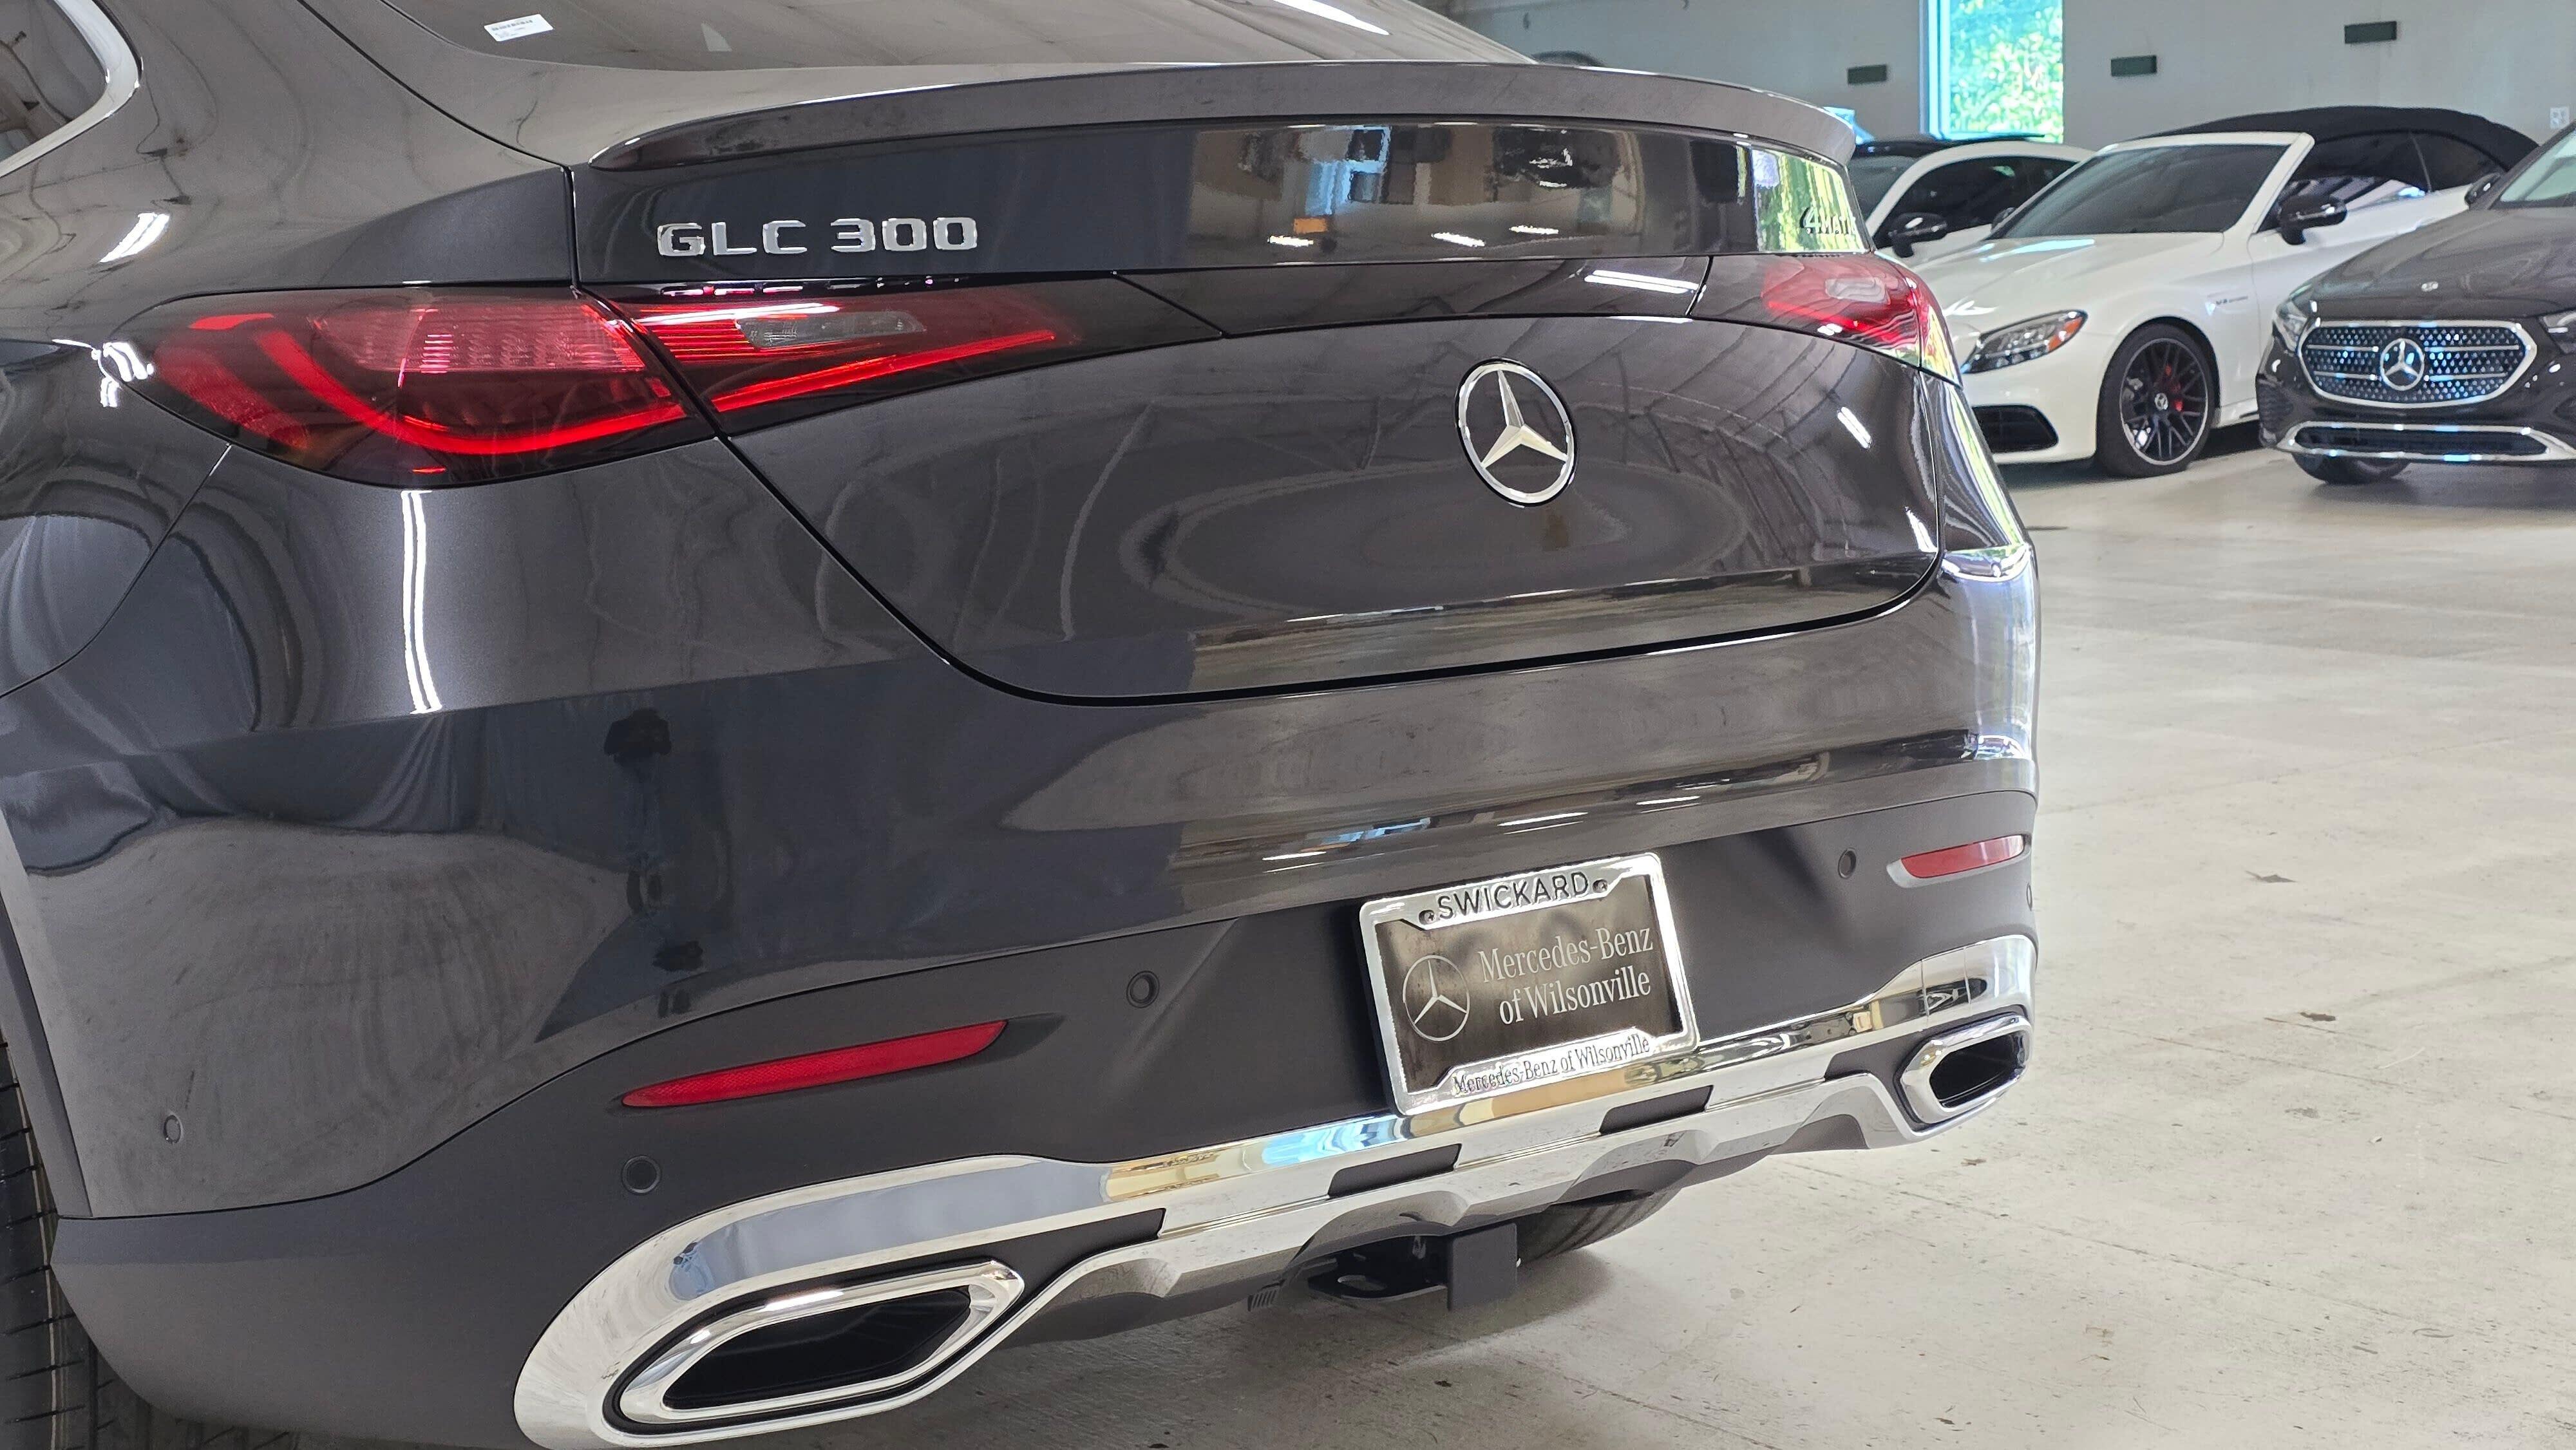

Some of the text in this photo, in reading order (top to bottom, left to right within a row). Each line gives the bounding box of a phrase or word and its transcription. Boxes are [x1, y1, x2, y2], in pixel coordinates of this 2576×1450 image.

[657, 217, 978, 256] GLC 300
[1438, 872, 1589, 920] SWICKARD
[1478, 927, 1654, 983] Mercedes-Benz
[1499, 965, 1652, 1025] of Wilsonville
[1453, 1034, 1651, 1094] Mercedes-Benz of Wilsonville
